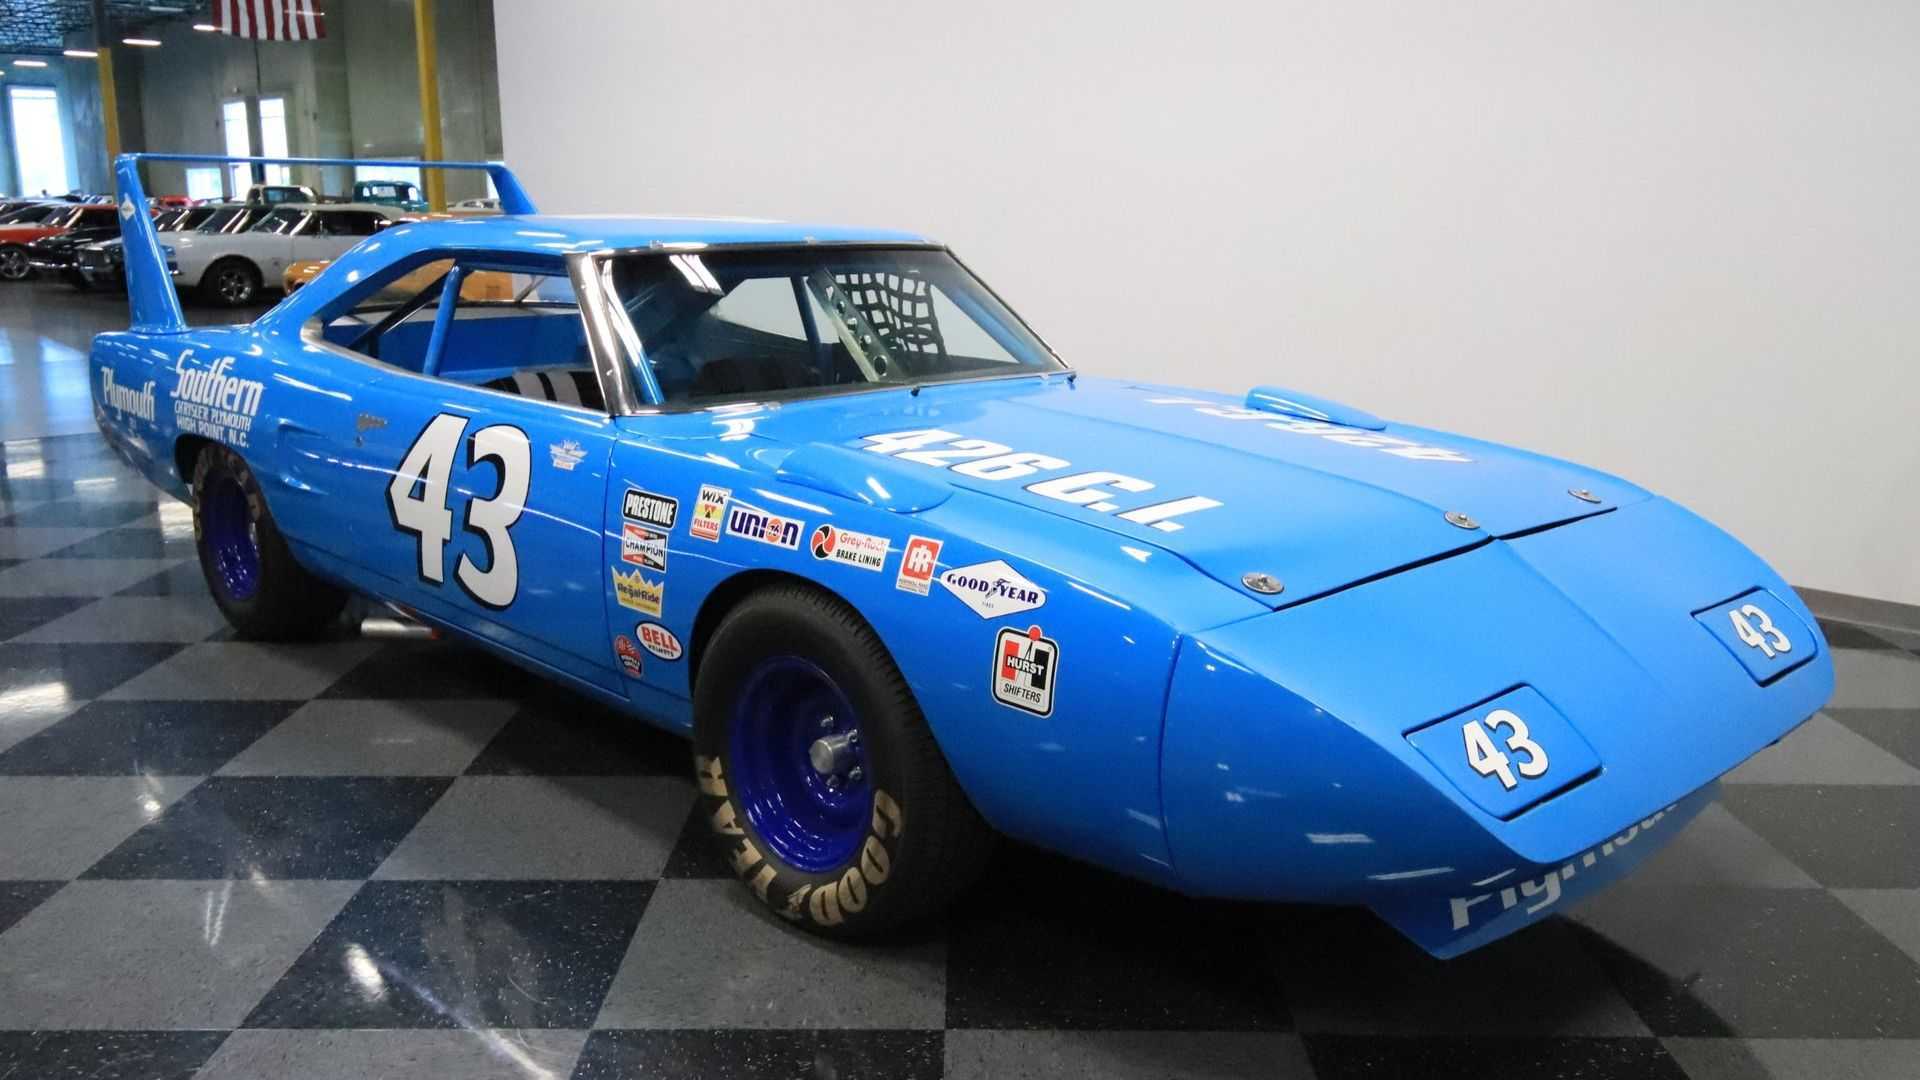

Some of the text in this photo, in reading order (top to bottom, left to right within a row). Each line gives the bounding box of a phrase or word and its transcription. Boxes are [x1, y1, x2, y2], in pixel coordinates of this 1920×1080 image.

[101, 365, 156, 422] Plymouth
[170, 349, 264, 417] Southern
[174, 400, 252, 432] CHRYSLER PLYMOUTH
[176, 413, 197, 434] HIGH
[228, 428, 250, 448] N.C.
[859, 426, 1073, 481] 426
[385, 411, 532, 612] 43
[625, 493, 676, 525] PRESTONE
[702, 490, 725, 504] WIX
[694, 518, 718, 531] FILTERS
[625, 538, 664, 557] CHAMPION
[836, 548, 881, 567] BRAKE LINING
[641, 626, 679, 652] BELL
[1727, 604, 1793, 659] 43
[1007, 656, 1045, 676] HURST
[1003, 683, 1041, 703] SHIFTERS
[1461, 709, 1550, 791] 43
